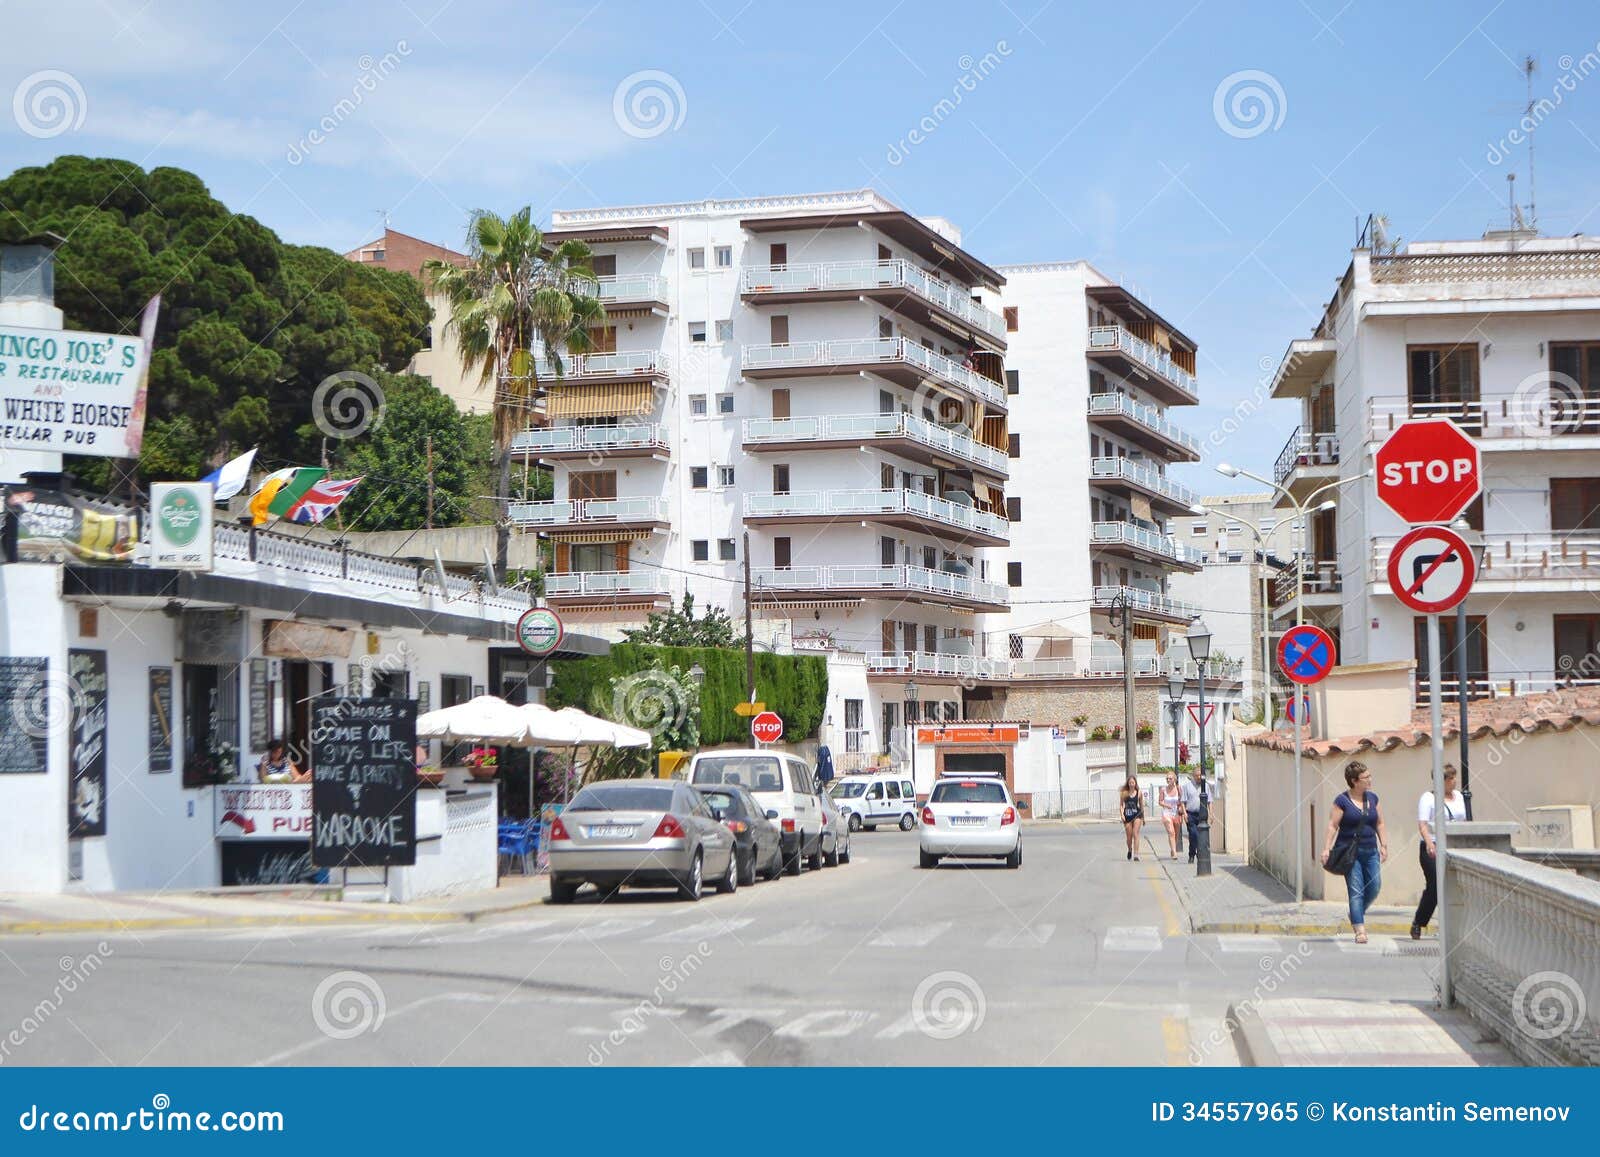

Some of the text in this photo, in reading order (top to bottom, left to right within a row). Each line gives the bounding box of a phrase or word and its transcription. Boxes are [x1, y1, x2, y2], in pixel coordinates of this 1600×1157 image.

[66, 337, 136, 368] JOE'S
[18, 364, 124, 386] RESTAURANT
[34, 384, 62, 396] AND
[4, 398, 131, 428] WHITE HORSE
[64, 430, 97, 444] PUB
[1382, 458, 1473, 487] STOP
[351, 705, 394, 720] HORSE
[368, 725, 391, 741] ON
[754, 723, 781, 732] STOP
[314, 765, 345, 782] HAVE
[349, 764, 360, 782] A
[315, 812, 408, 847] KARAOKE
